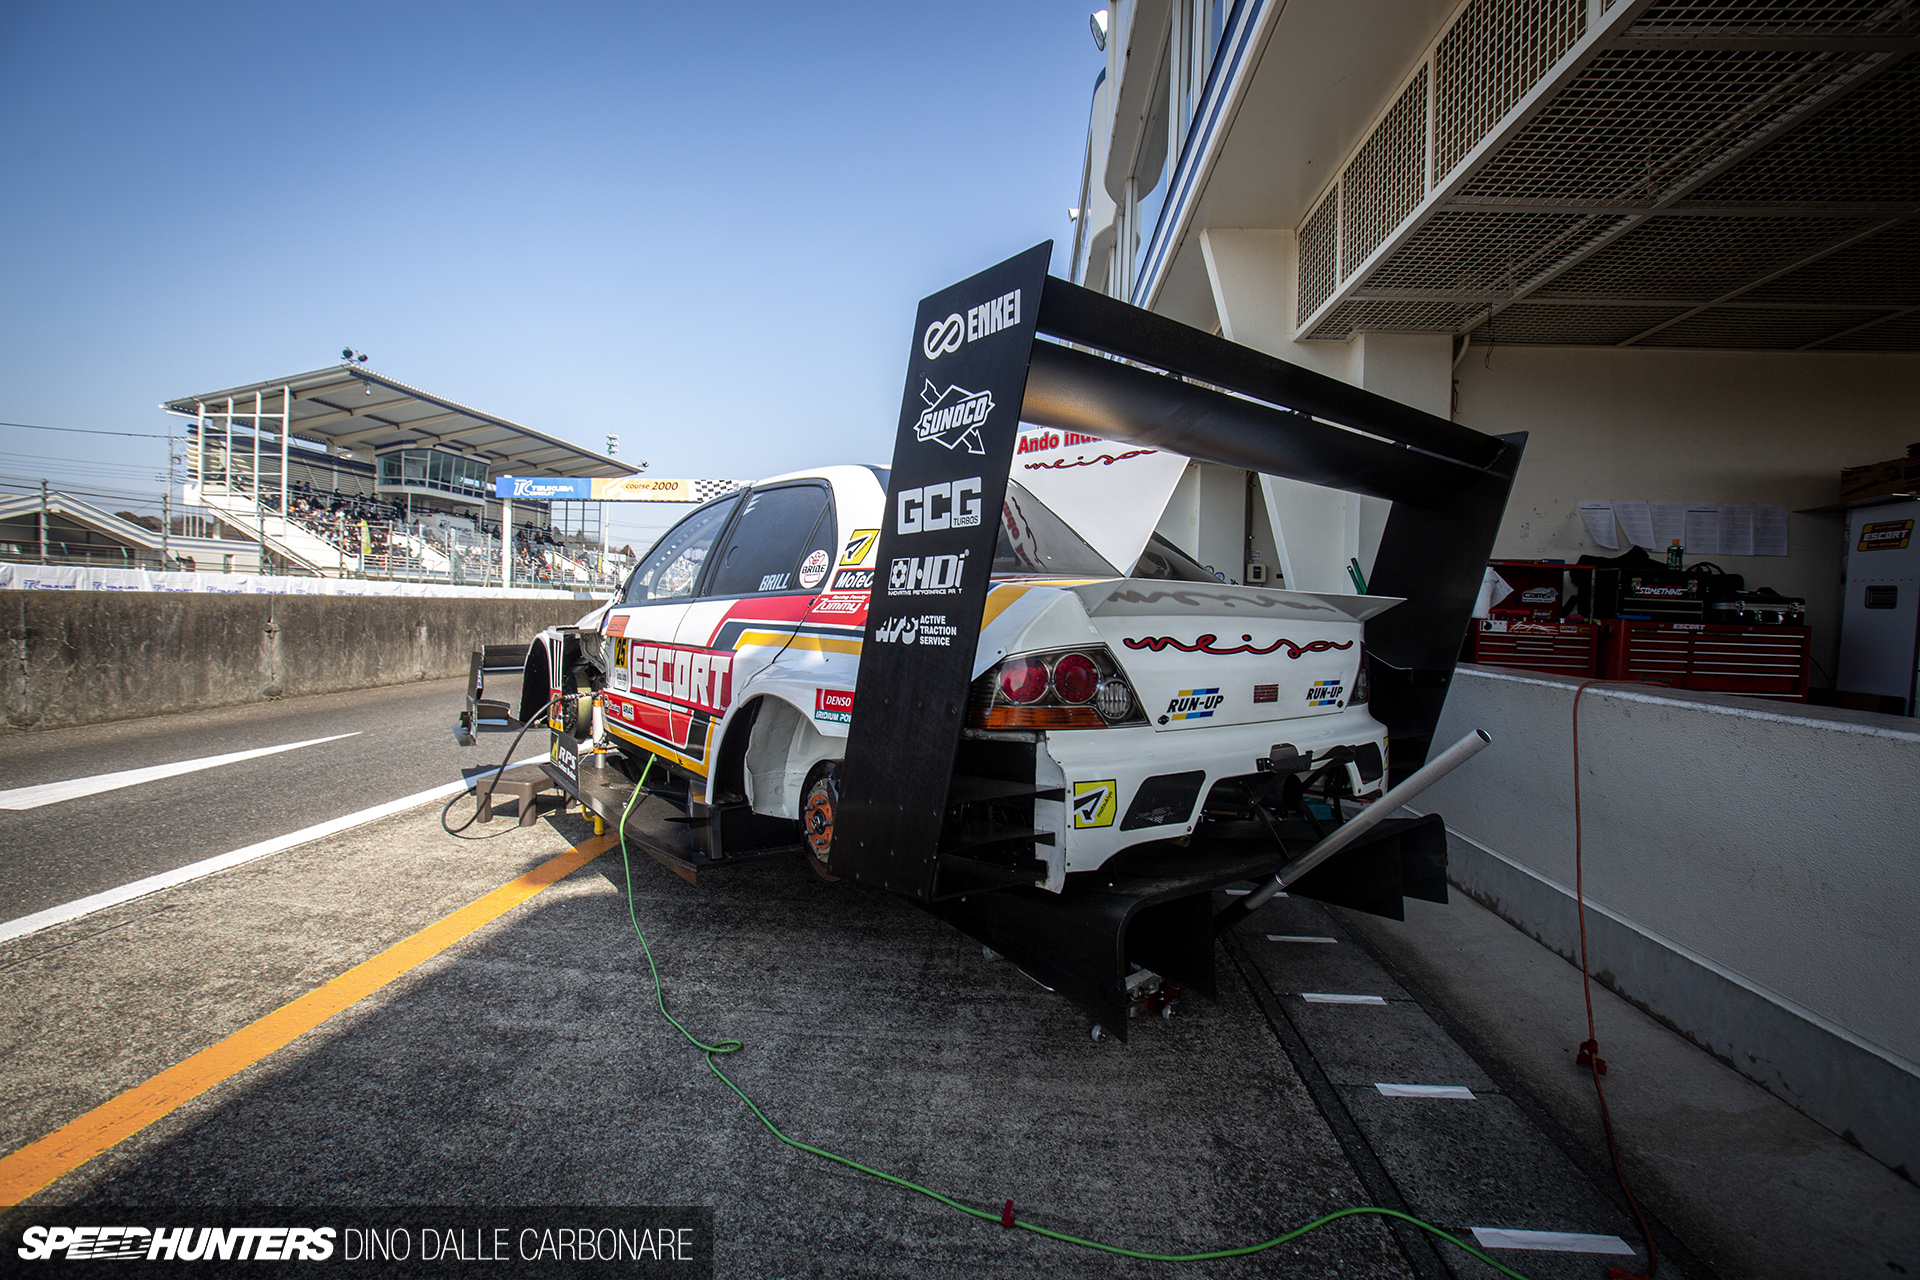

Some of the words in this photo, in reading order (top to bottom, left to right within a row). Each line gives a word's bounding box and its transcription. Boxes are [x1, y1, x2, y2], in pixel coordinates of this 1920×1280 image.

[967, 288, 1021, 343] ENKEI
[920, 396, 988, 437] SUNOCO
[1017, 431, 1060, 455] Ando
[625, 482, 650, 490] course
[651, 481, 679, 491] 2000
[897, 476, 982, 535] GCG
[953, 515, 979, 527] TURBOS
[1863, 529, 1909, 542] ESCORT
[802, 564, 827, 574] BRIDE
[758, 572, 791, 591] BRILL
[835, 571, 875, 589] MoTeC
[1635, 586, 1688, 596] SOMETHING
[920, 615, 947, 625] ACTIVE
[920, 625, 957, 636] TRACTION
[920, 636, 951, 646] SERVICE
[616, 638, 627, 667] 25
[632, 645, 732, 710] ESCORT
[826, 695, 852, 707] DENSO
[1306, 685, 1344, 701] RUN-UP
[1166, 695, 1225, 713] RUN-UP
[815, 710, 839, 721] IRIDIUM
[558, 745, 577, 771] RPS
